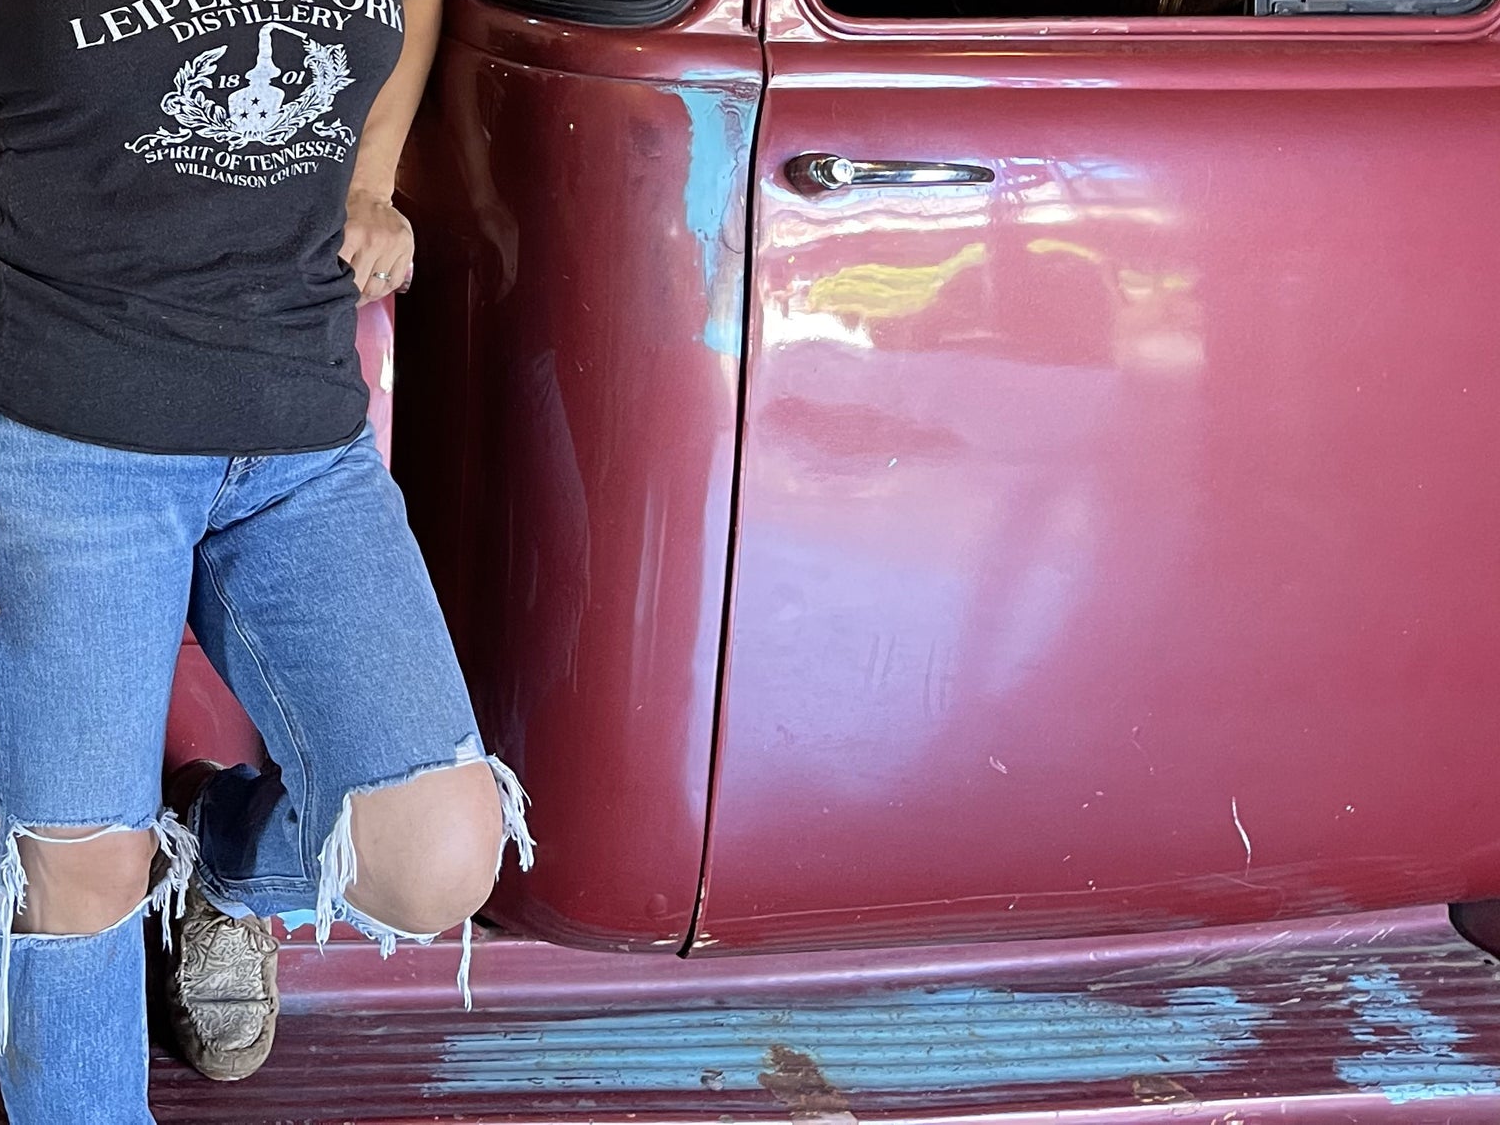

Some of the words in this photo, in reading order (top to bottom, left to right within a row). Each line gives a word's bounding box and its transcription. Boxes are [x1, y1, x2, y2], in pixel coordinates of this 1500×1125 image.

[170, 3, 352, 44] DISTILLERY
[218, 73, 240, 89] 18
[282, 71, 304, 86] 01
[144, 144, 213, 164] SPIRIT
[216, 151, 241, 169] OF
[244, 142, 347, 172] TENNESSEE
[174, 162, 267, 188] WILLIAMSON
[269, 161, 320, 186] COUNTY
